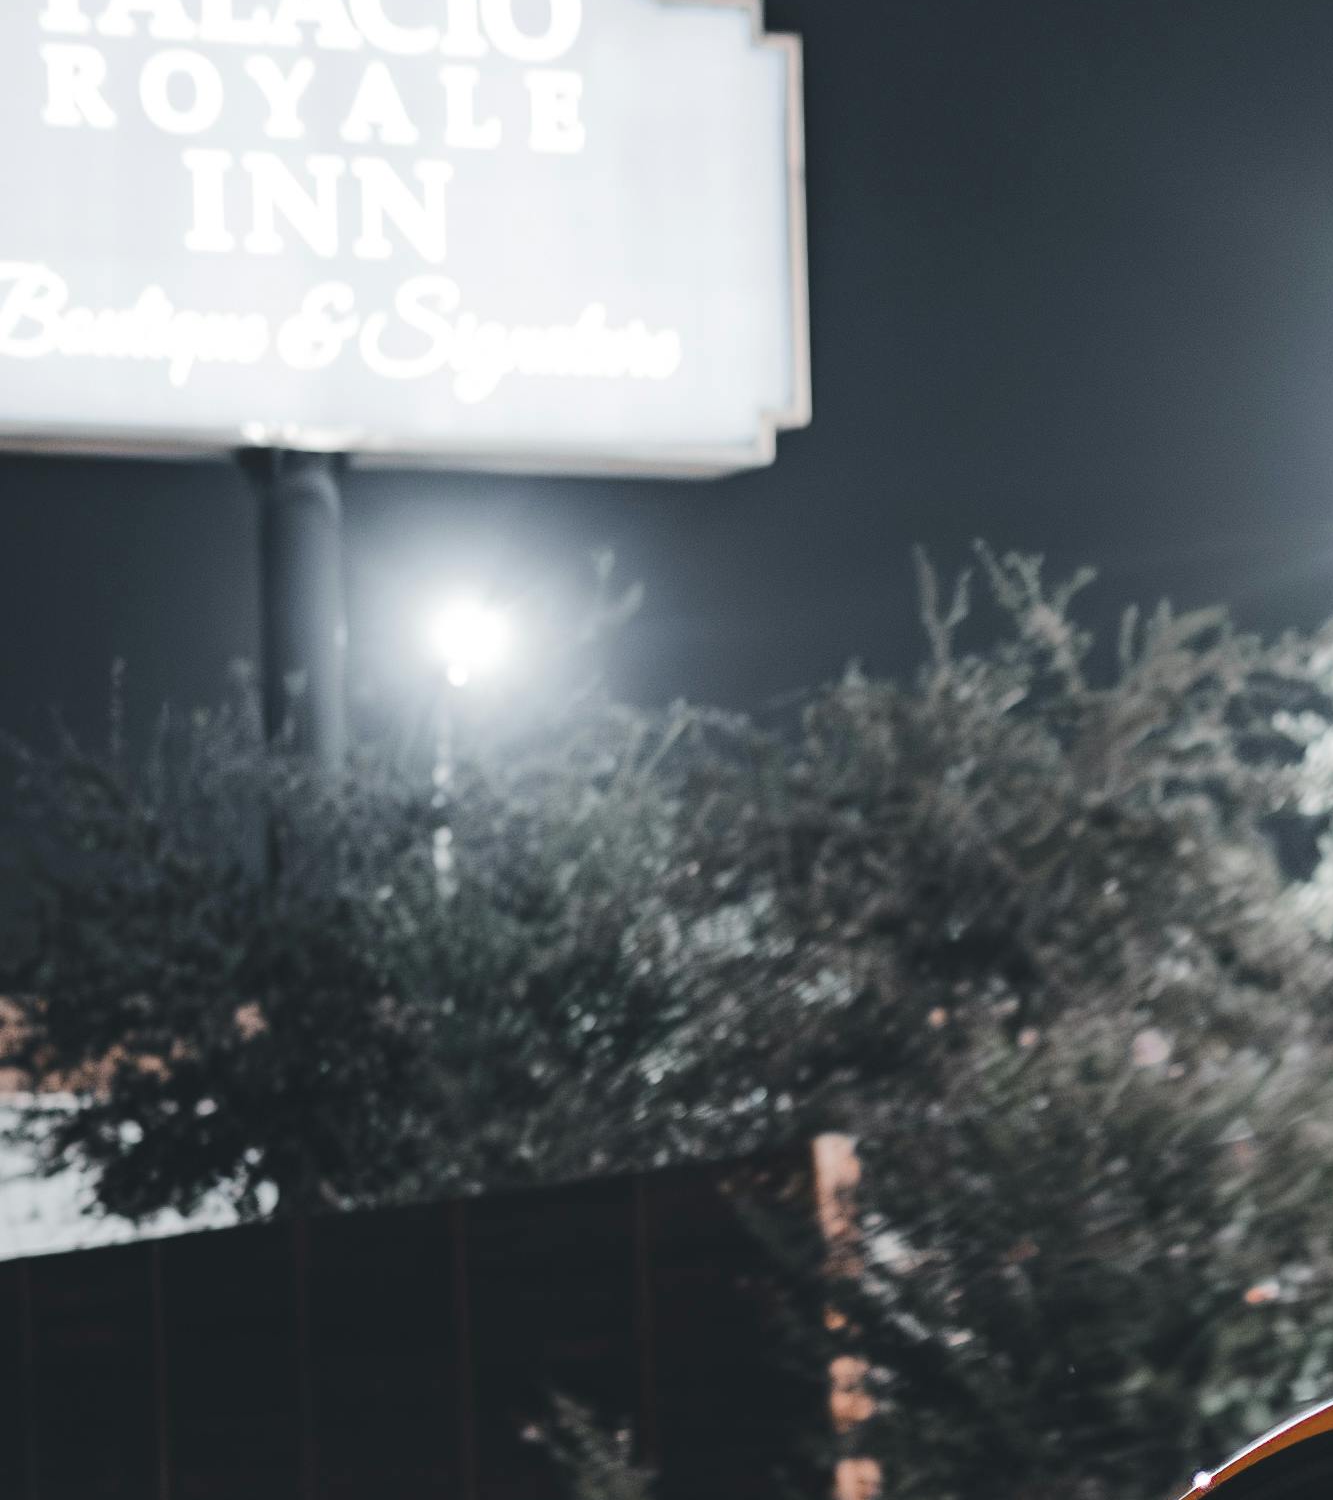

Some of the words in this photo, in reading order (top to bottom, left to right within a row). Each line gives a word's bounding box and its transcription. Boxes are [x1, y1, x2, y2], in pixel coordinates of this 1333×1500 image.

[38, 42, 586, 153] ROYALE
[182, 148, 454, 264] INN
[276, 280, 360, 370] &
